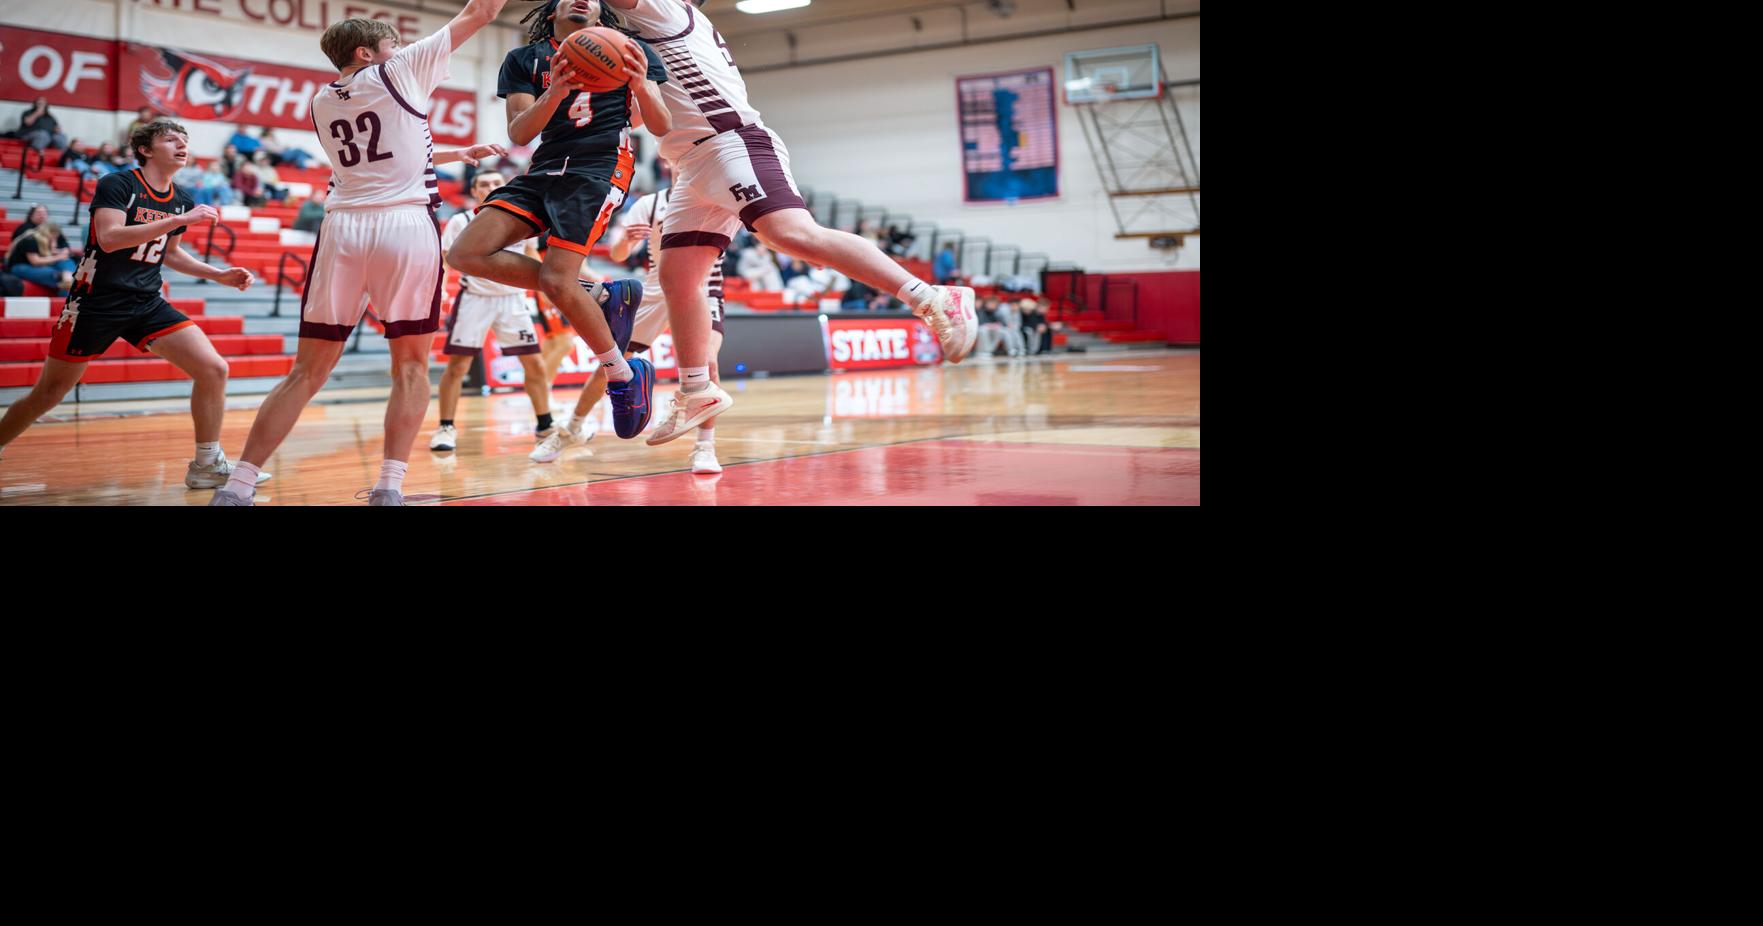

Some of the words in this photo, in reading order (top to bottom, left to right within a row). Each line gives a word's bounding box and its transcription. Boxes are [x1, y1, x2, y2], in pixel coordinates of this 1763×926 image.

[239, 0, 420, 44] COLLE
[575, 34, 617, 70] Wilson
[18, 45, 108, 93] OF
[244, 74, 326, 121] TH
[428, 98, 474, 137] LS
[568, 91, 593, 129] 4
[330, 111, 393, 168] 32
[729, 183, 762, 202] FM
[130, 233, 168, 264] 12
[831, 328, 909, 362] STATE
